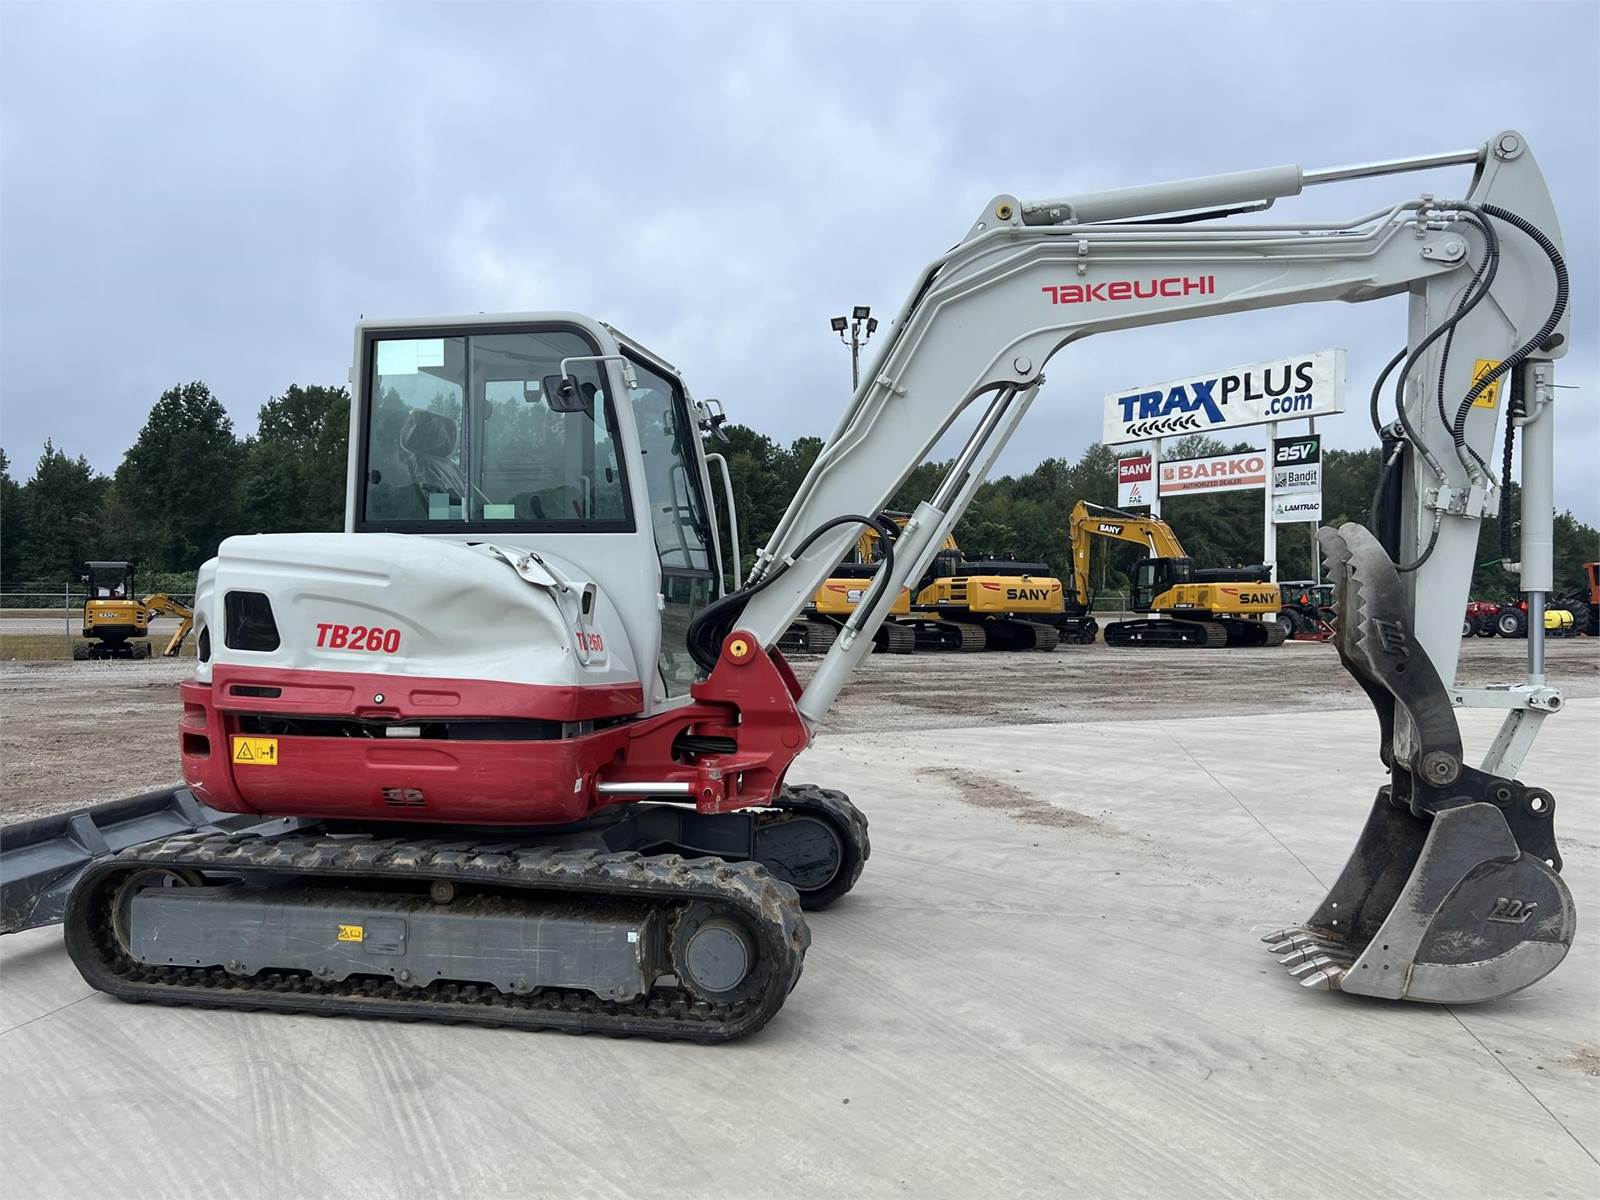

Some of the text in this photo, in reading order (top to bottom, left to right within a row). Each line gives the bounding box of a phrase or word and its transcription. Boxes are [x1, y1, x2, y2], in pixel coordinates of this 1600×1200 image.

[1264, 393, 1313, 416] .com
[1120, 463, 1151, 477] SANY
[1178, 456, 1265, 480] BARKO
[1288, 470, 1317, 482] Bandit
[1183, 478, 1242, 489] AUTHORIZED DEALER
[1284, 503, 1320, 512] LAMTRAC
[1099, 523, 1121, 535] SANY
[1007, 588, 1050, 600] SANY
[1239, 592, 1275, 604] SANY
[315, 623, 401, 653] TB260
